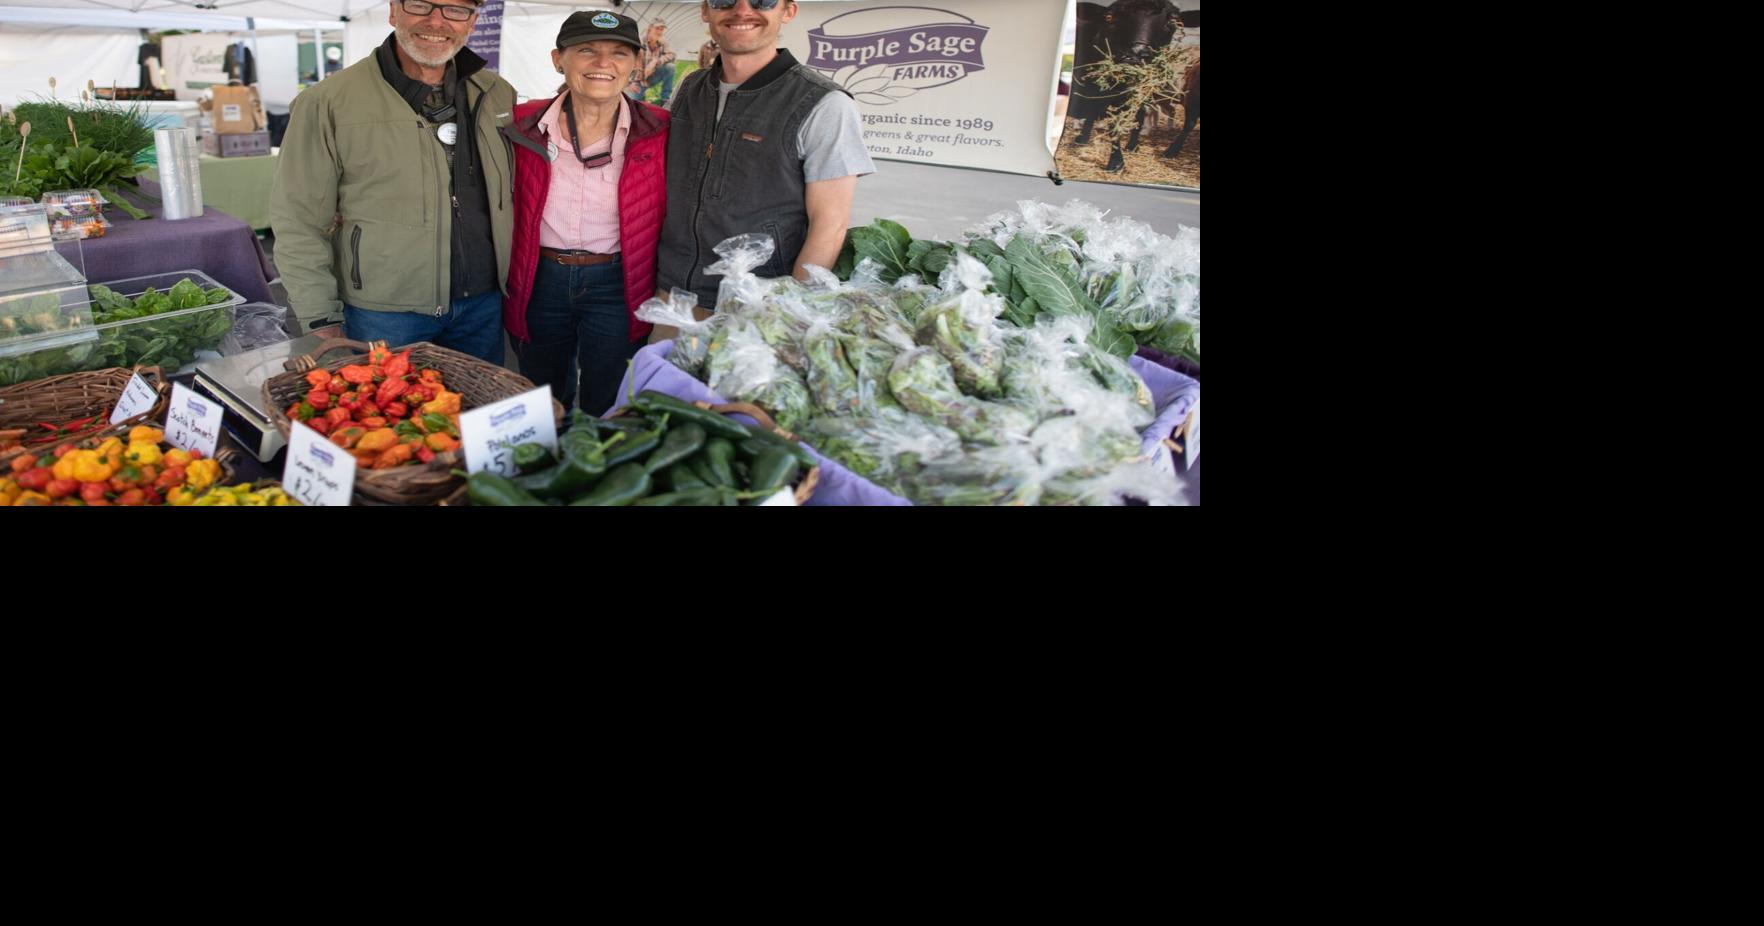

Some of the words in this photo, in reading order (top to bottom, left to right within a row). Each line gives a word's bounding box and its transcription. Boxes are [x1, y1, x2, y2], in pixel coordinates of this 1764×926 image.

[815, 37, 900, 65] Purple
[908, 32, 976, 57] Sage
[892, 64, 960, 81] FARMS
[860, 113, 907, 126] rganic
[910, 114, 951, 127] since
[956, 118, 994, 131] 1989
[862, 129, 901, 140] greens
[904, 132, 913, 141] &
[915, 132, 950, 143] great
[953, 133, 1005, 147] flavors.
[866, 145, 892, 155] ton,
[896, 145, 933, 157] Idaho
